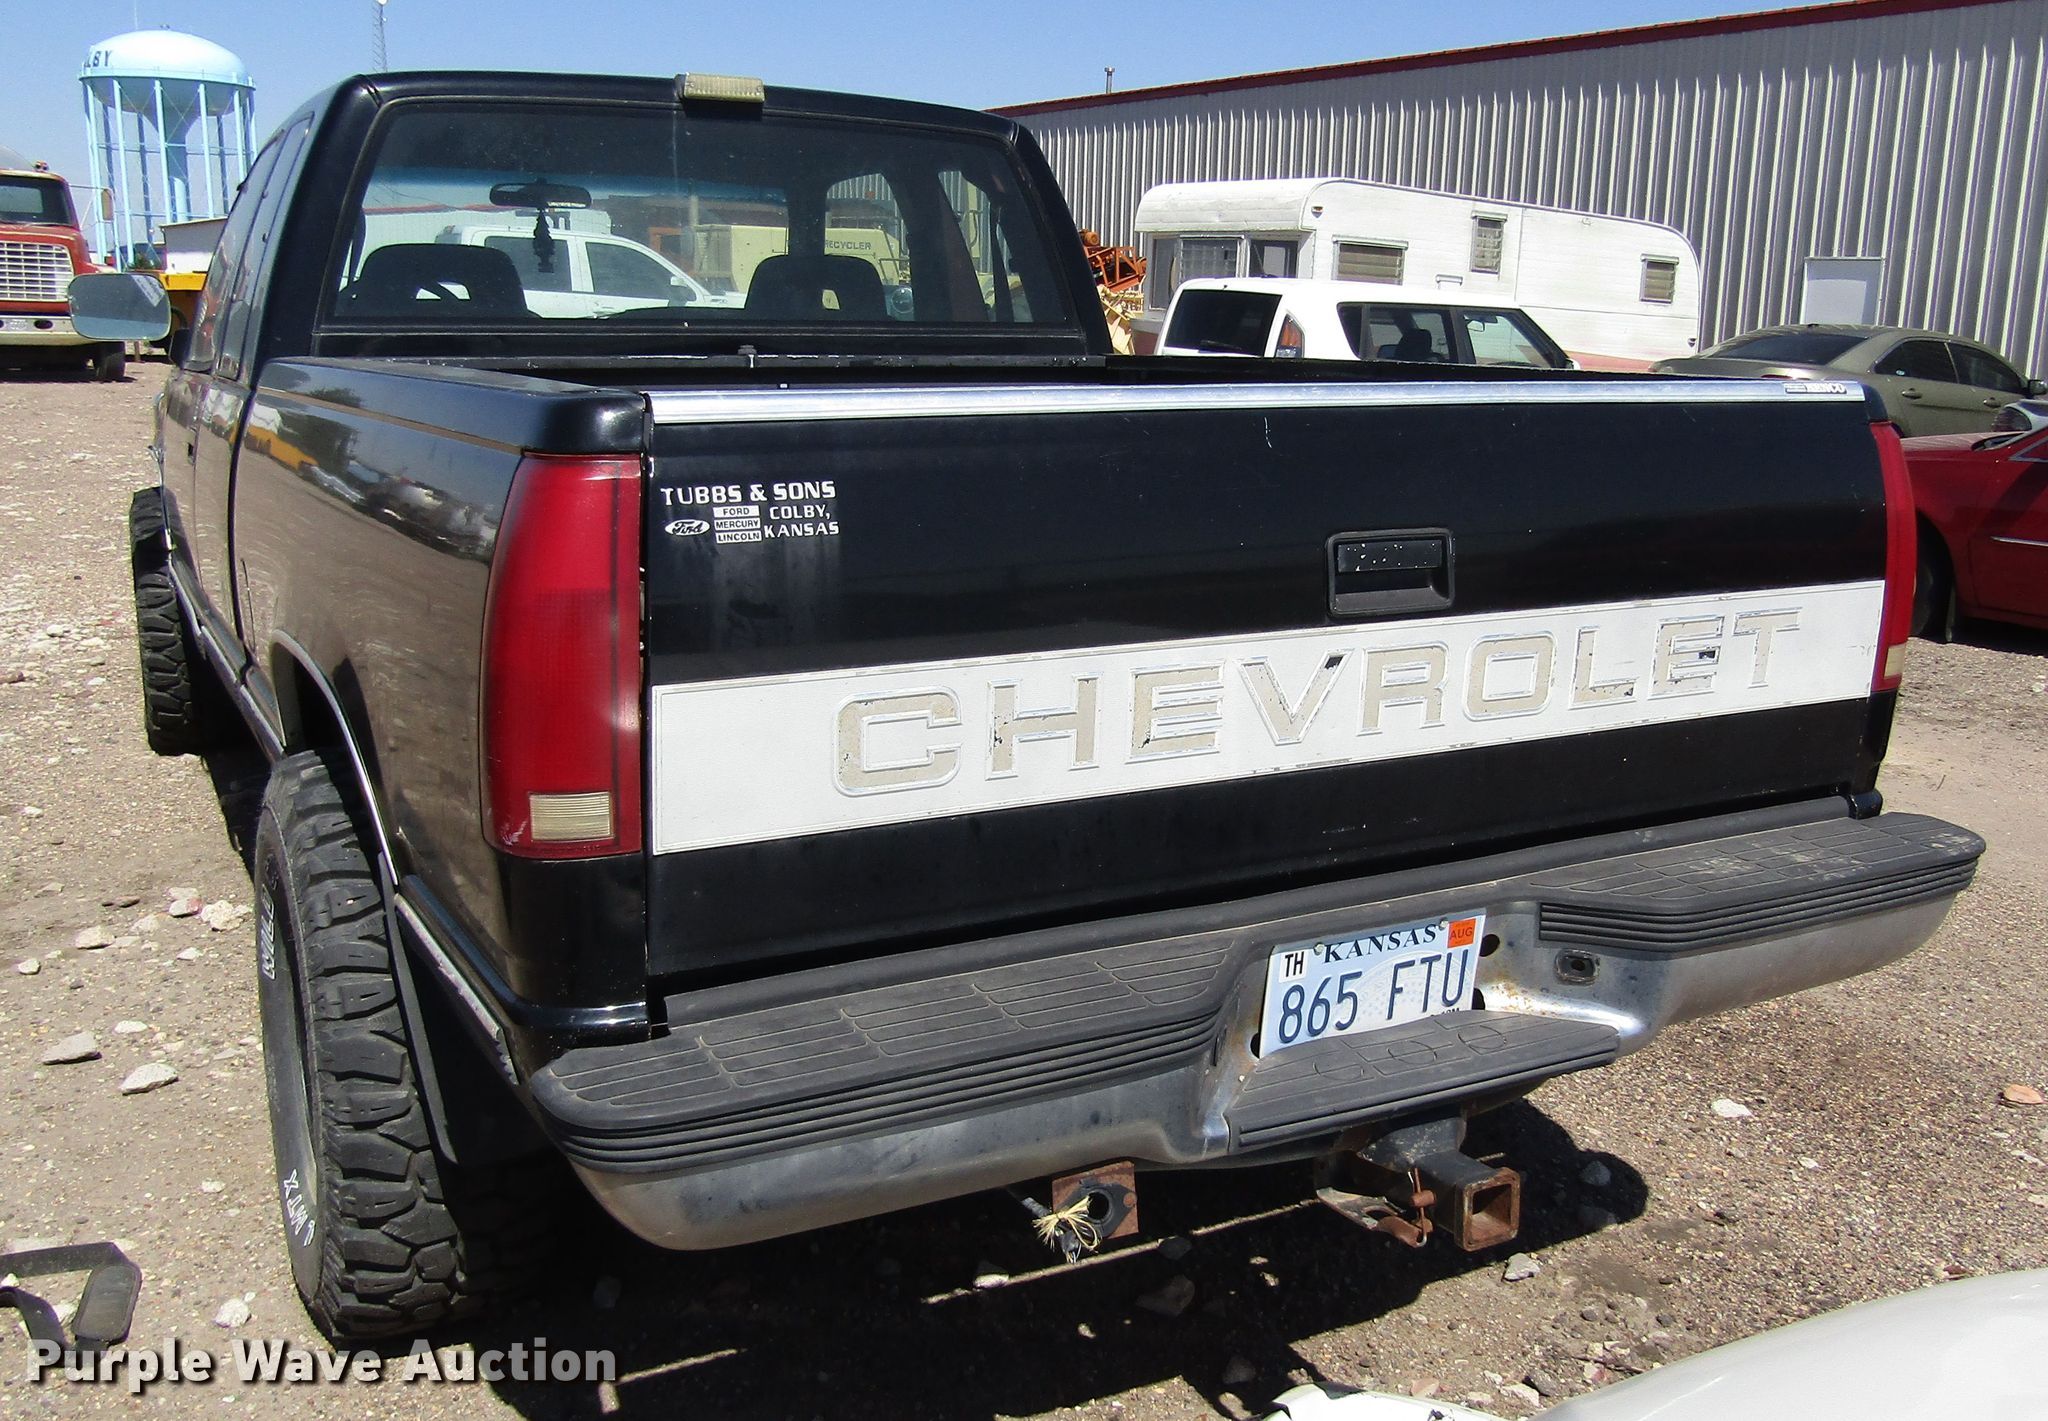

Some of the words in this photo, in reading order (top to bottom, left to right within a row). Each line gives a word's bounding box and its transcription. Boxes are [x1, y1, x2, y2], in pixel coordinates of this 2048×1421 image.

[660, 485, 742, 506] TUBBS
[750, 484, 768, 501] &
[773, 481, 836, 500] SONS
[722, 506, 750, 516] FORD
[769, 504, 831, 520] COLBY,
[670, 520, 706, 536] Ford
[716, 519, 759, 530] MERCURY
[764, 521, 839, 539] KANSAS
[717, 532, 760, 542] LINCOLN
[834, 606, 1802, 796] CHEVROLET
[1450, 927, 1473, 940] AUG
[1324, 923, 1438, 964] KANSAS
[1285, 951, 1305, 977] TH
[1279, 971, 1363, 1043] 865
[1386, 949, 1468, 1020] FTU
